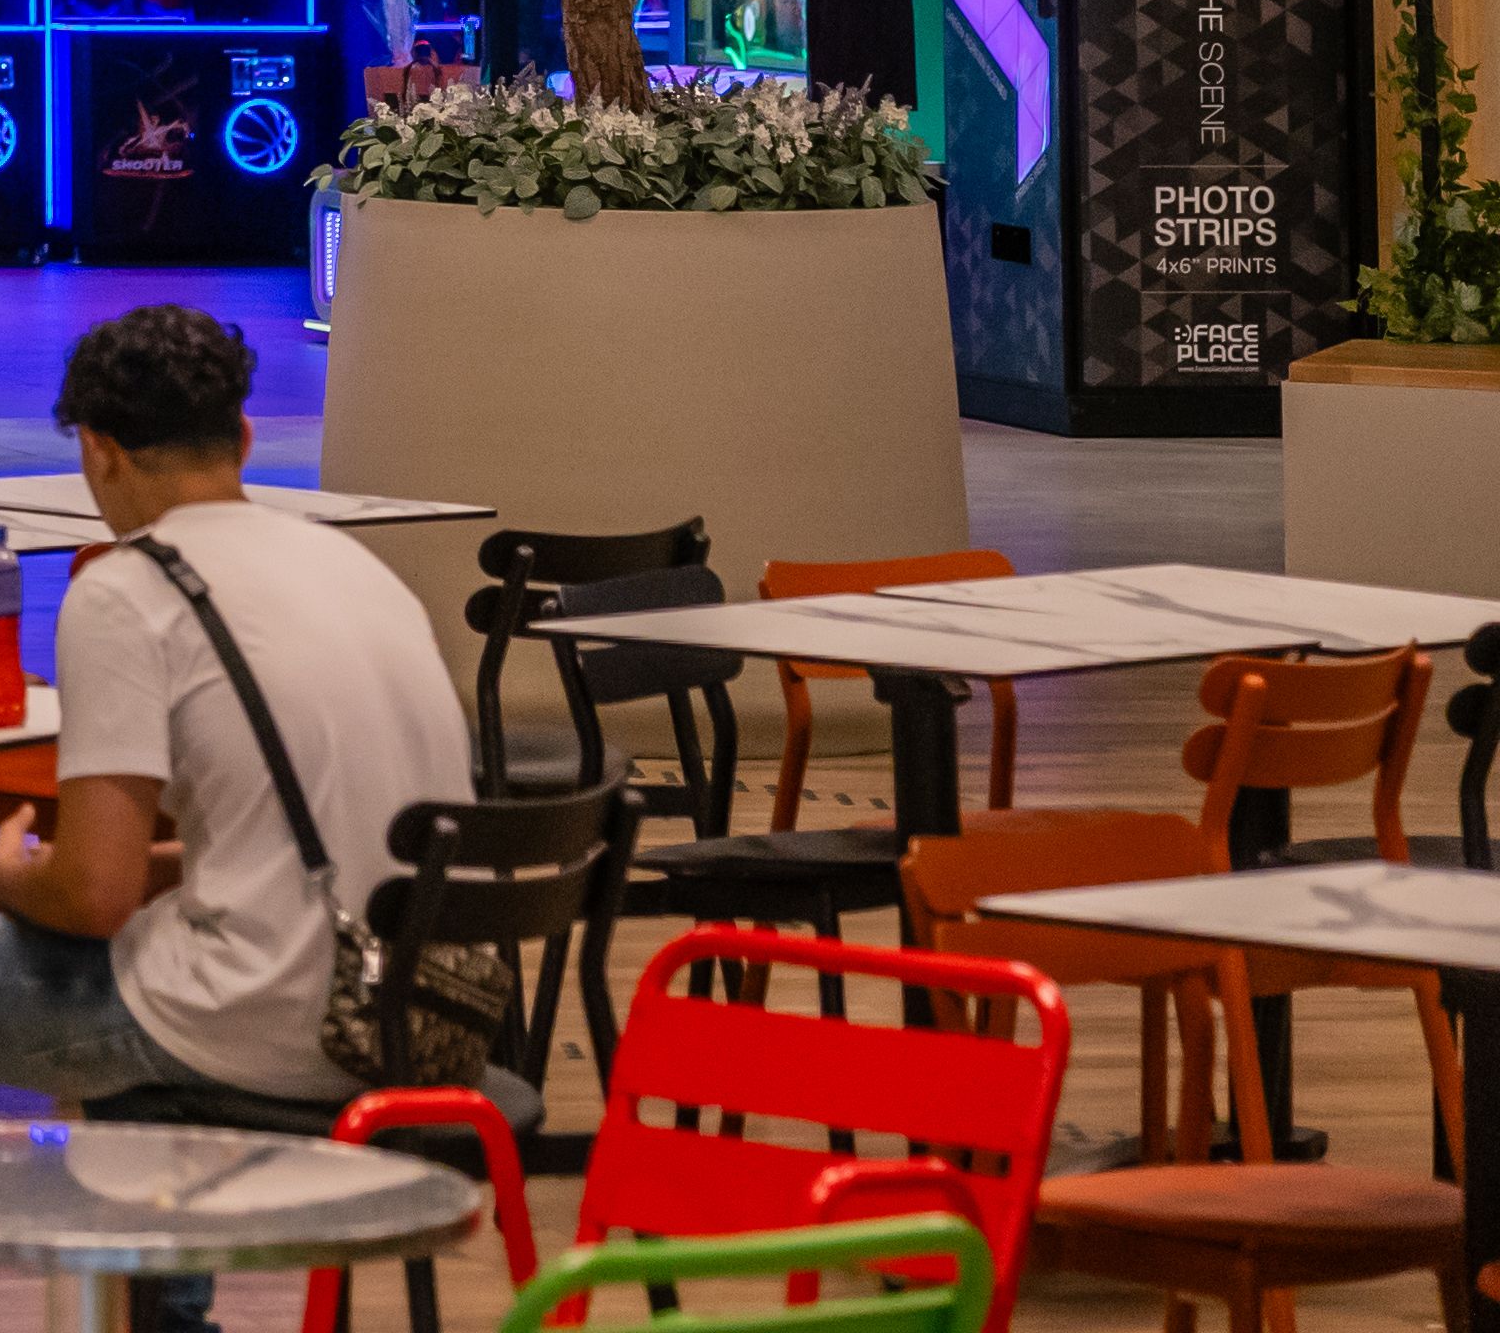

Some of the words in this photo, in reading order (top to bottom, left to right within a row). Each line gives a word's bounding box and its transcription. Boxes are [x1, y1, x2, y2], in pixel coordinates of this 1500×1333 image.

[1199, 41, 1226, 145] SCENE
[1154, 185, 1276, 215] PHOTO
[1154, 217, 1277, 247] STRIPS
[1206, 257, 1277, 274] PRINTS
[1177, 344, 1259, 363] PLACE
